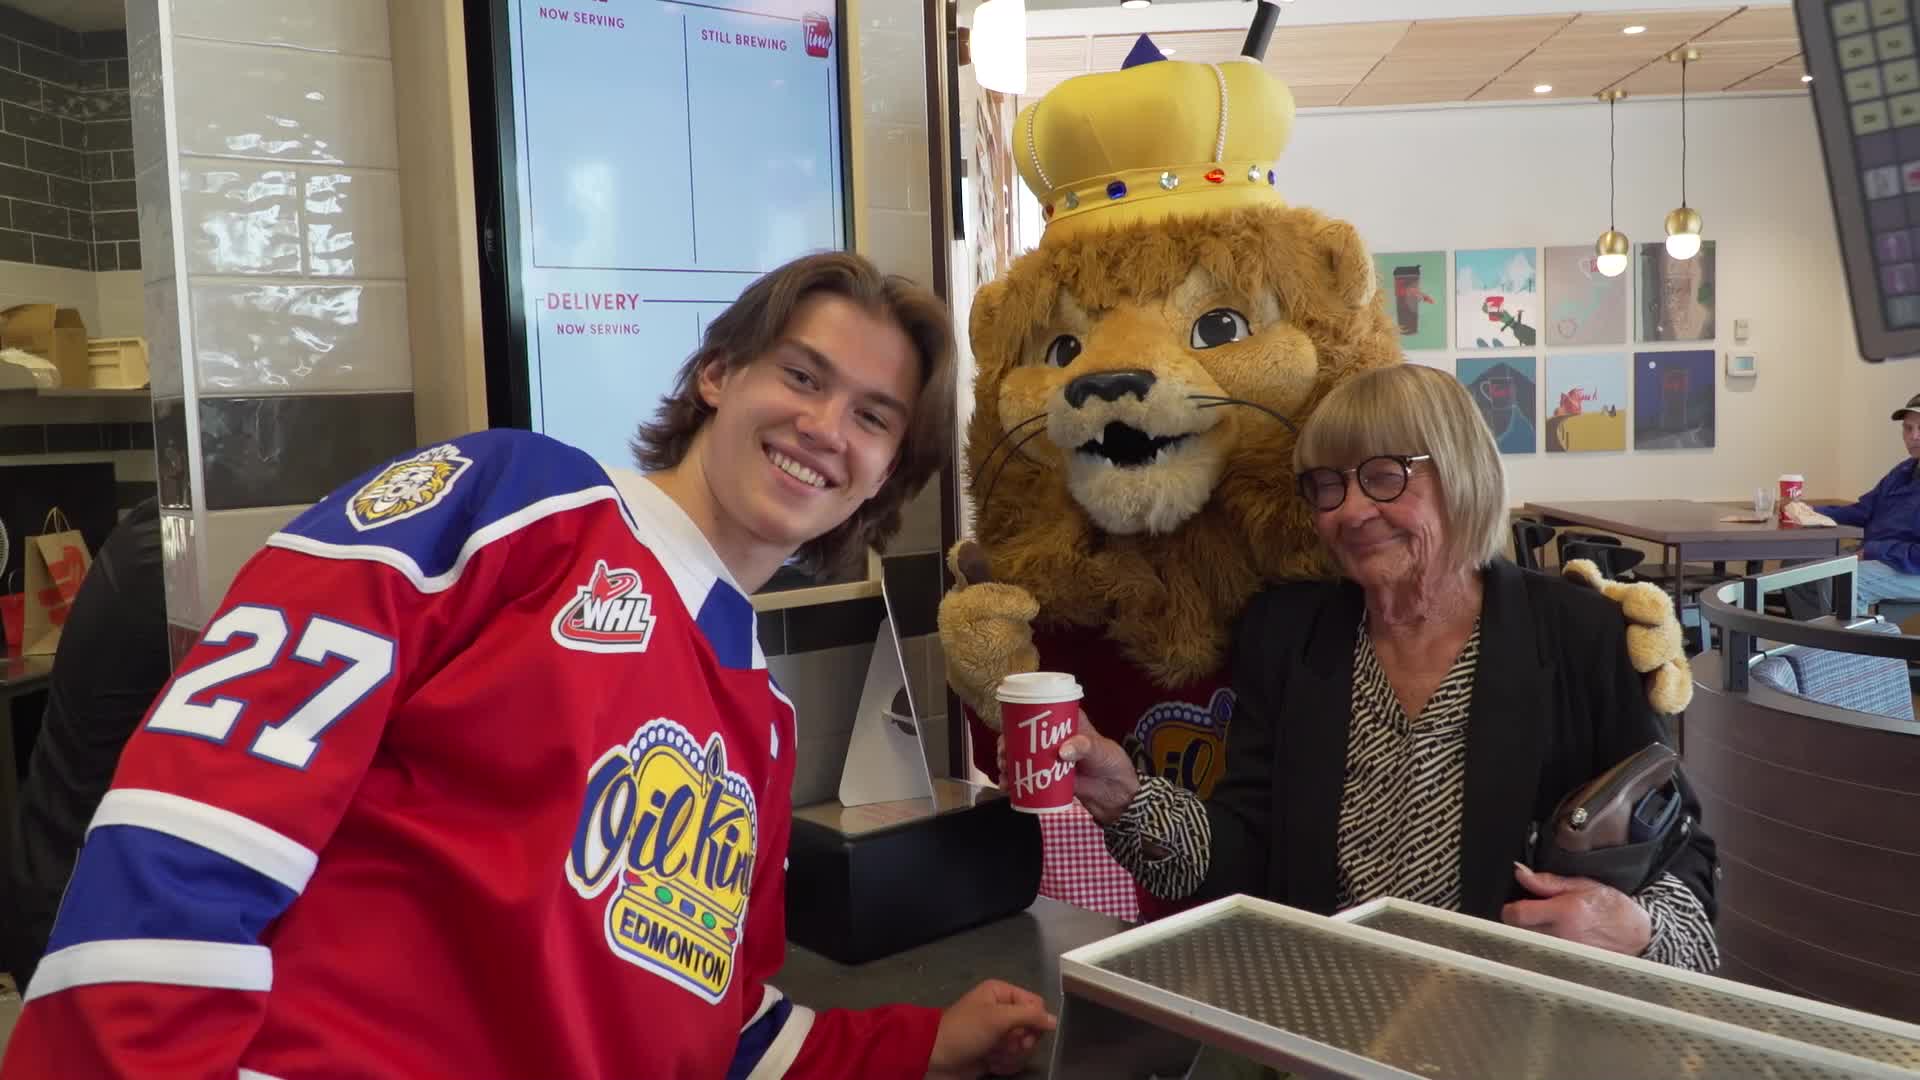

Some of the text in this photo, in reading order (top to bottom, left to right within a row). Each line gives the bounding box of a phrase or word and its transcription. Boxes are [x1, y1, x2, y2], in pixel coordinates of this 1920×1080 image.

[539, 7, 625, 29] NOW SERVING
[701, 29, 788, 51] STILL BREWING
[547, 292, 640, 311] DELIVERY
[556, 323, 640, 335] NOW SERVING
[582, 592, 649, 632] WHL
[145, 602, 398, 772] 27
[1018, 710, 1072, 754] Tim
[1014, 758, 1077, 799] Hor
[570, 754, 752, 896] Oil Kin
[619, 906, 726, 986] EDMONTON
